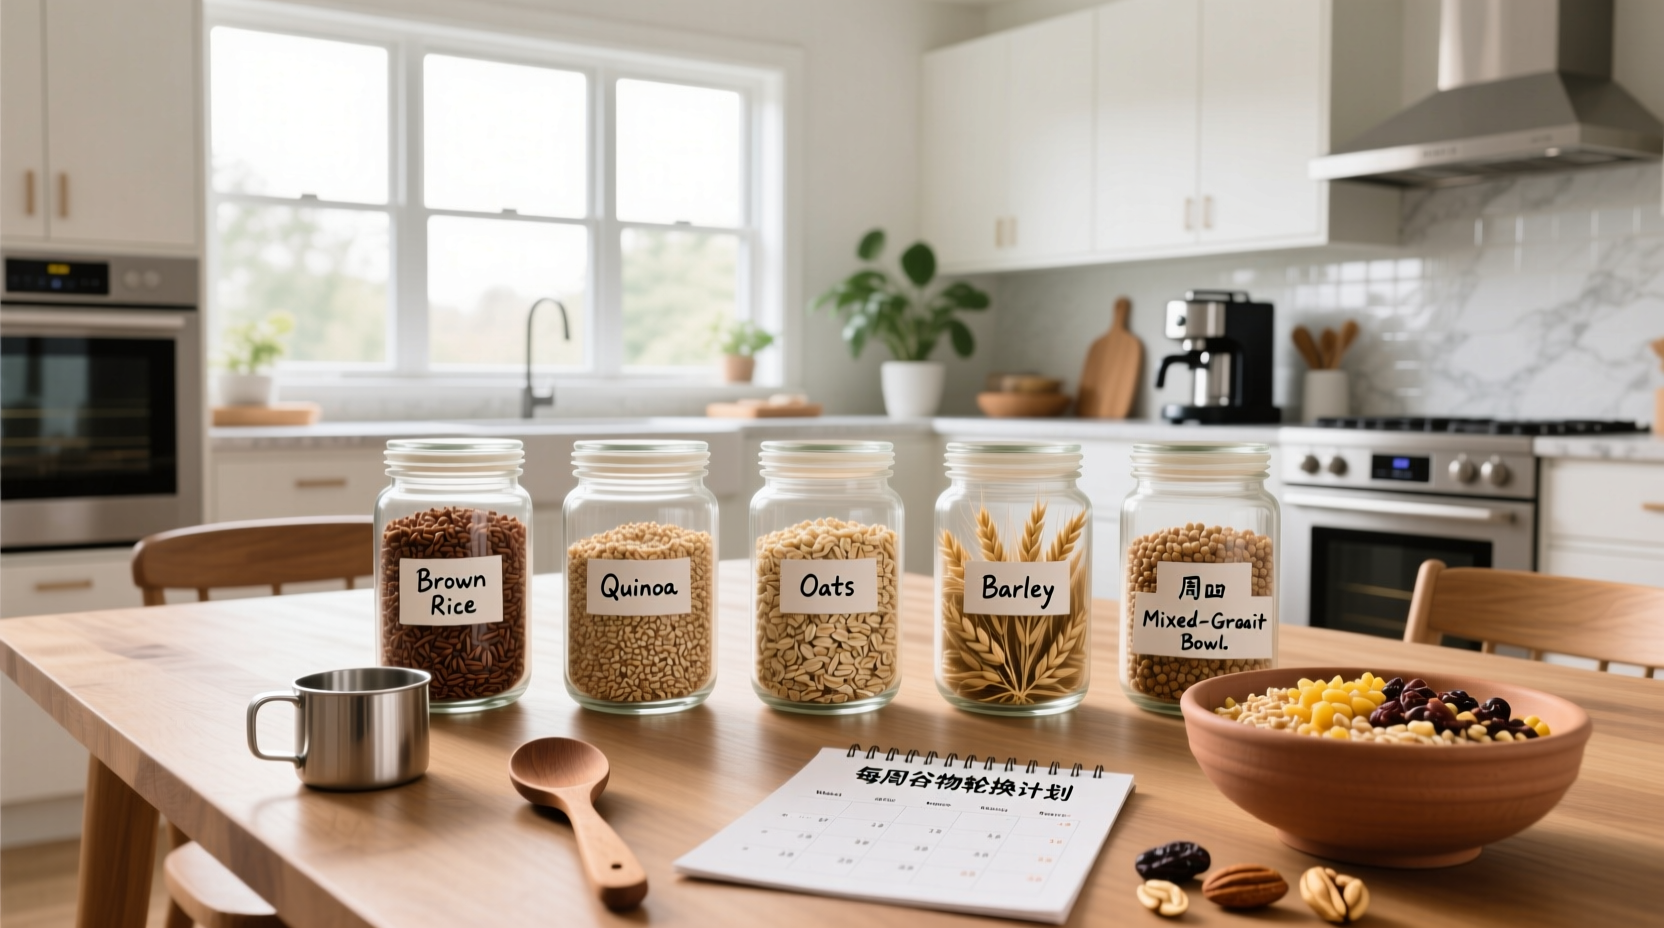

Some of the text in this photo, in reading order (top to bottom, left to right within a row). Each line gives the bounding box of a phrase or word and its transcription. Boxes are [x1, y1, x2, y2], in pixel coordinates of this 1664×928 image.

[416, 567, 486, 592] Brown
[600, 572, 679, 601] Quinoa
[799, 573, 855, 598] Oats
[982, 574, 1055, 609] Barley
[431, 594, 477, 615] Rice
[856, 766, 1074, 801] 每周谷物轮换计划
